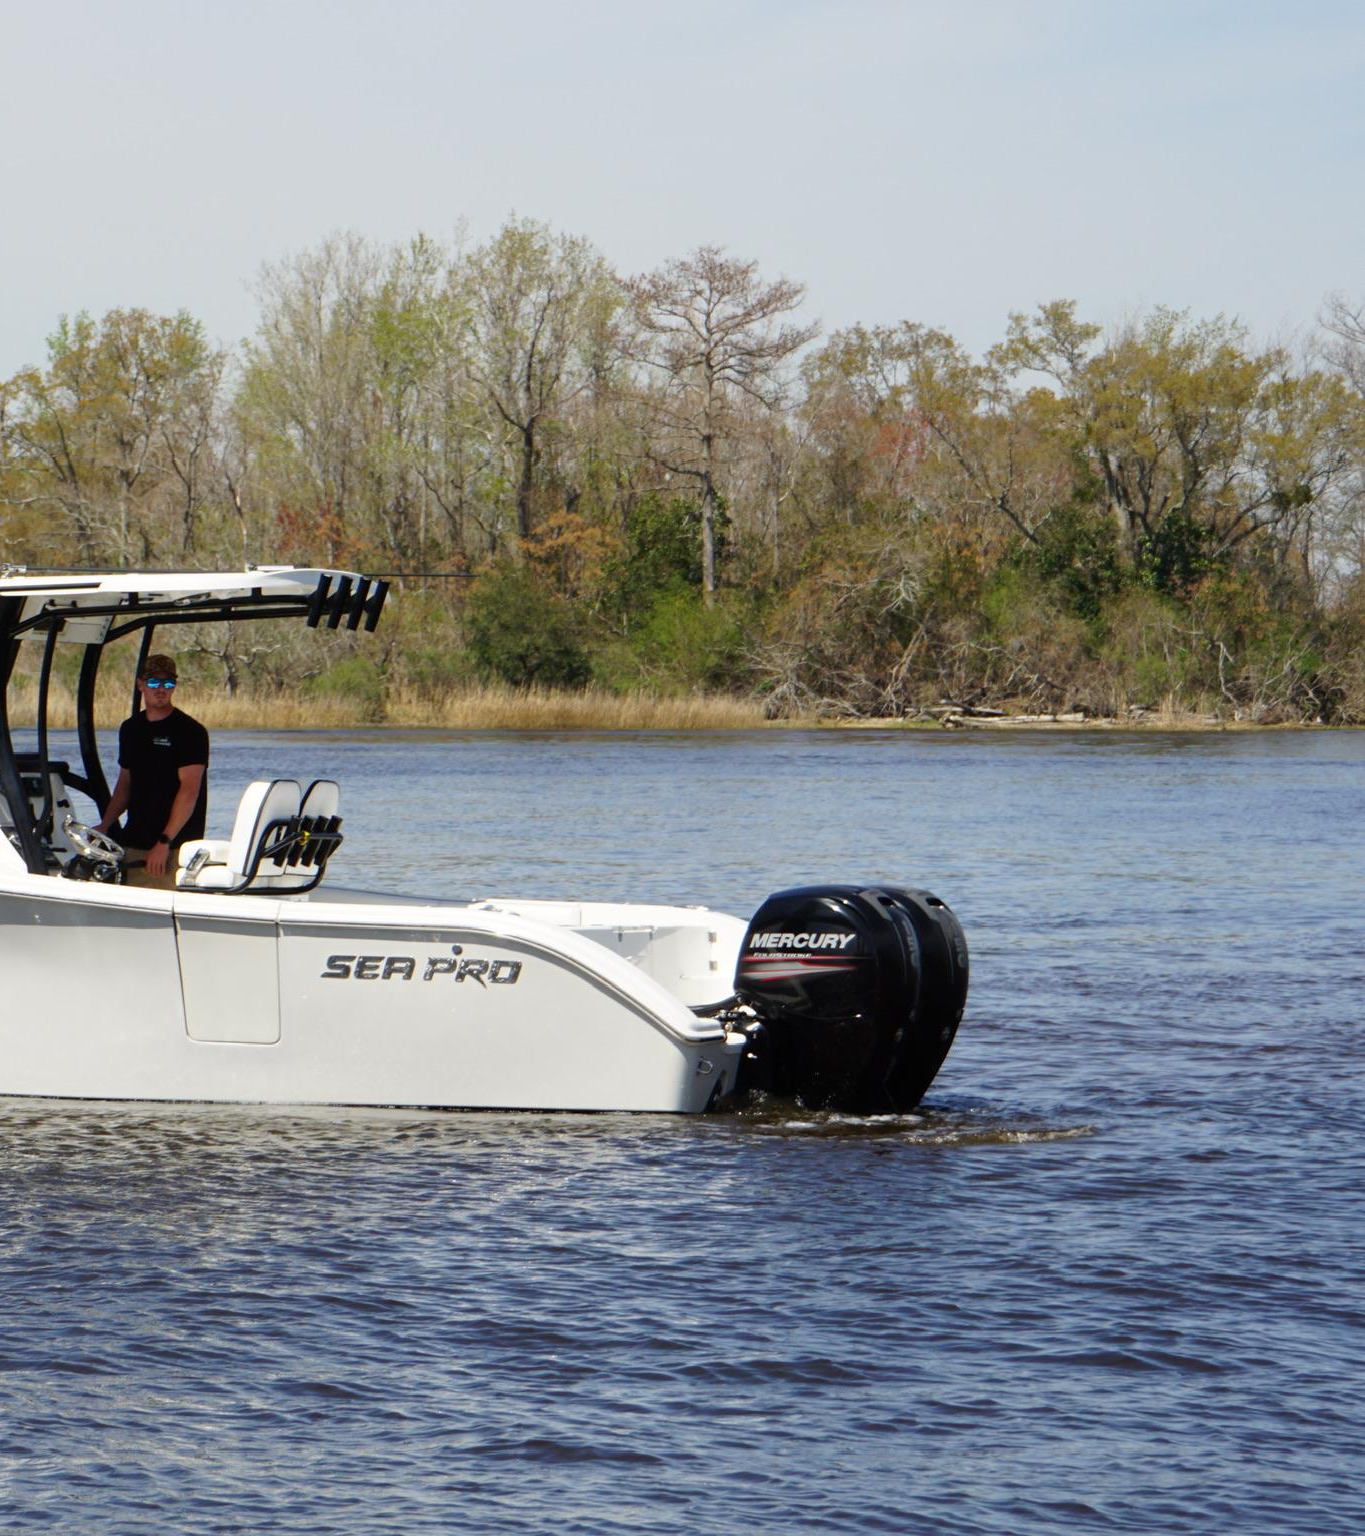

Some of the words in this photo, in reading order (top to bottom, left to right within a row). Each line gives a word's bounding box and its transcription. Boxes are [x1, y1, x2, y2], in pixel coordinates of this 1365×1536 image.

[749, 933, 856, 949] MERCURY
[321, 954, 415, 980] SEA
[423, 956, 522, 989] PRO
